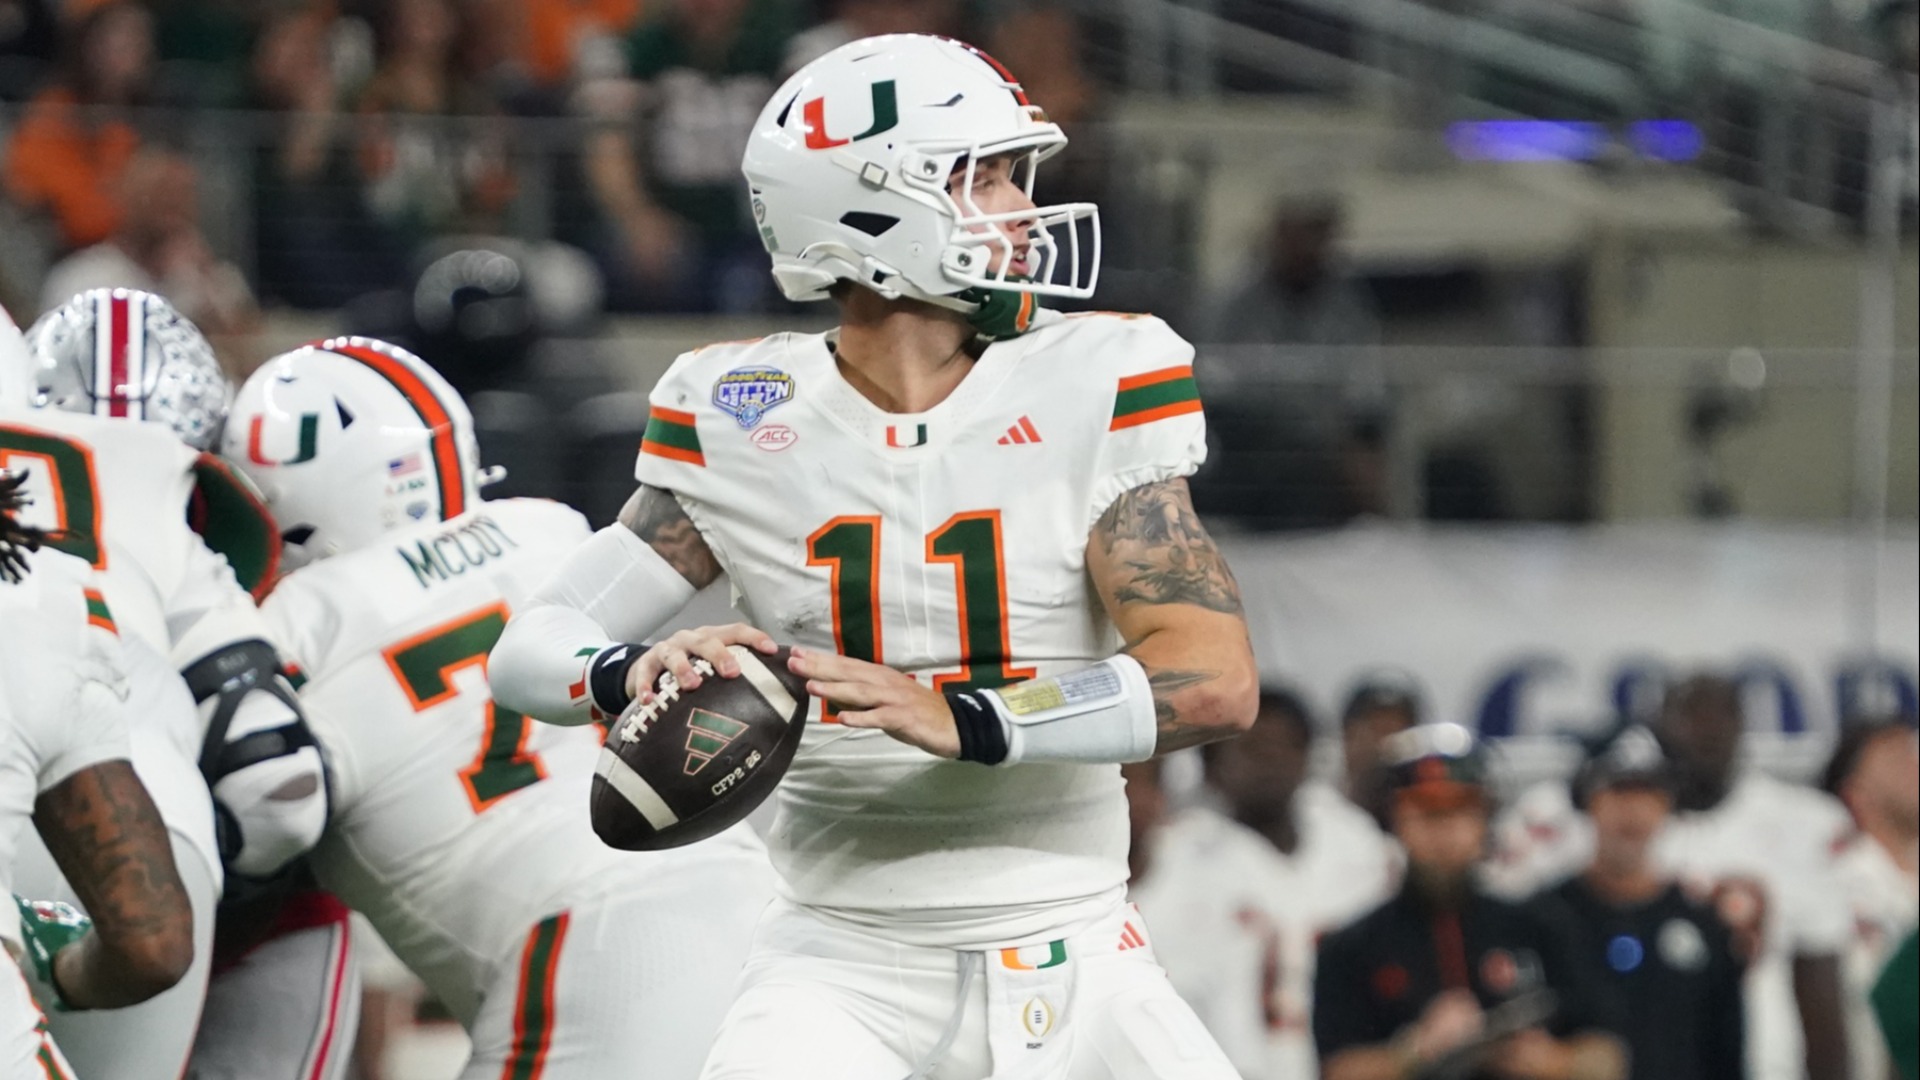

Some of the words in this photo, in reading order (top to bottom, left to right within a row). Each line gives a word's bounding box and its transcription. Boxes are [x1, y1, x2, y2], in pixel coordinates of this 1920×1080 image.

[803, 79, 899, 150] U
[718, 381, 789, 403] COTTON
[247, 412, 318, 468] U
[757, 430, 791, 442] ACC
[886, 423, 928, 449] U
[396, 516, 519, 589] MCCOY
[805, 509, 1037, 724] 11
[381, 599, 609, 816] 7
[1000, 938, 1068, 970] U
